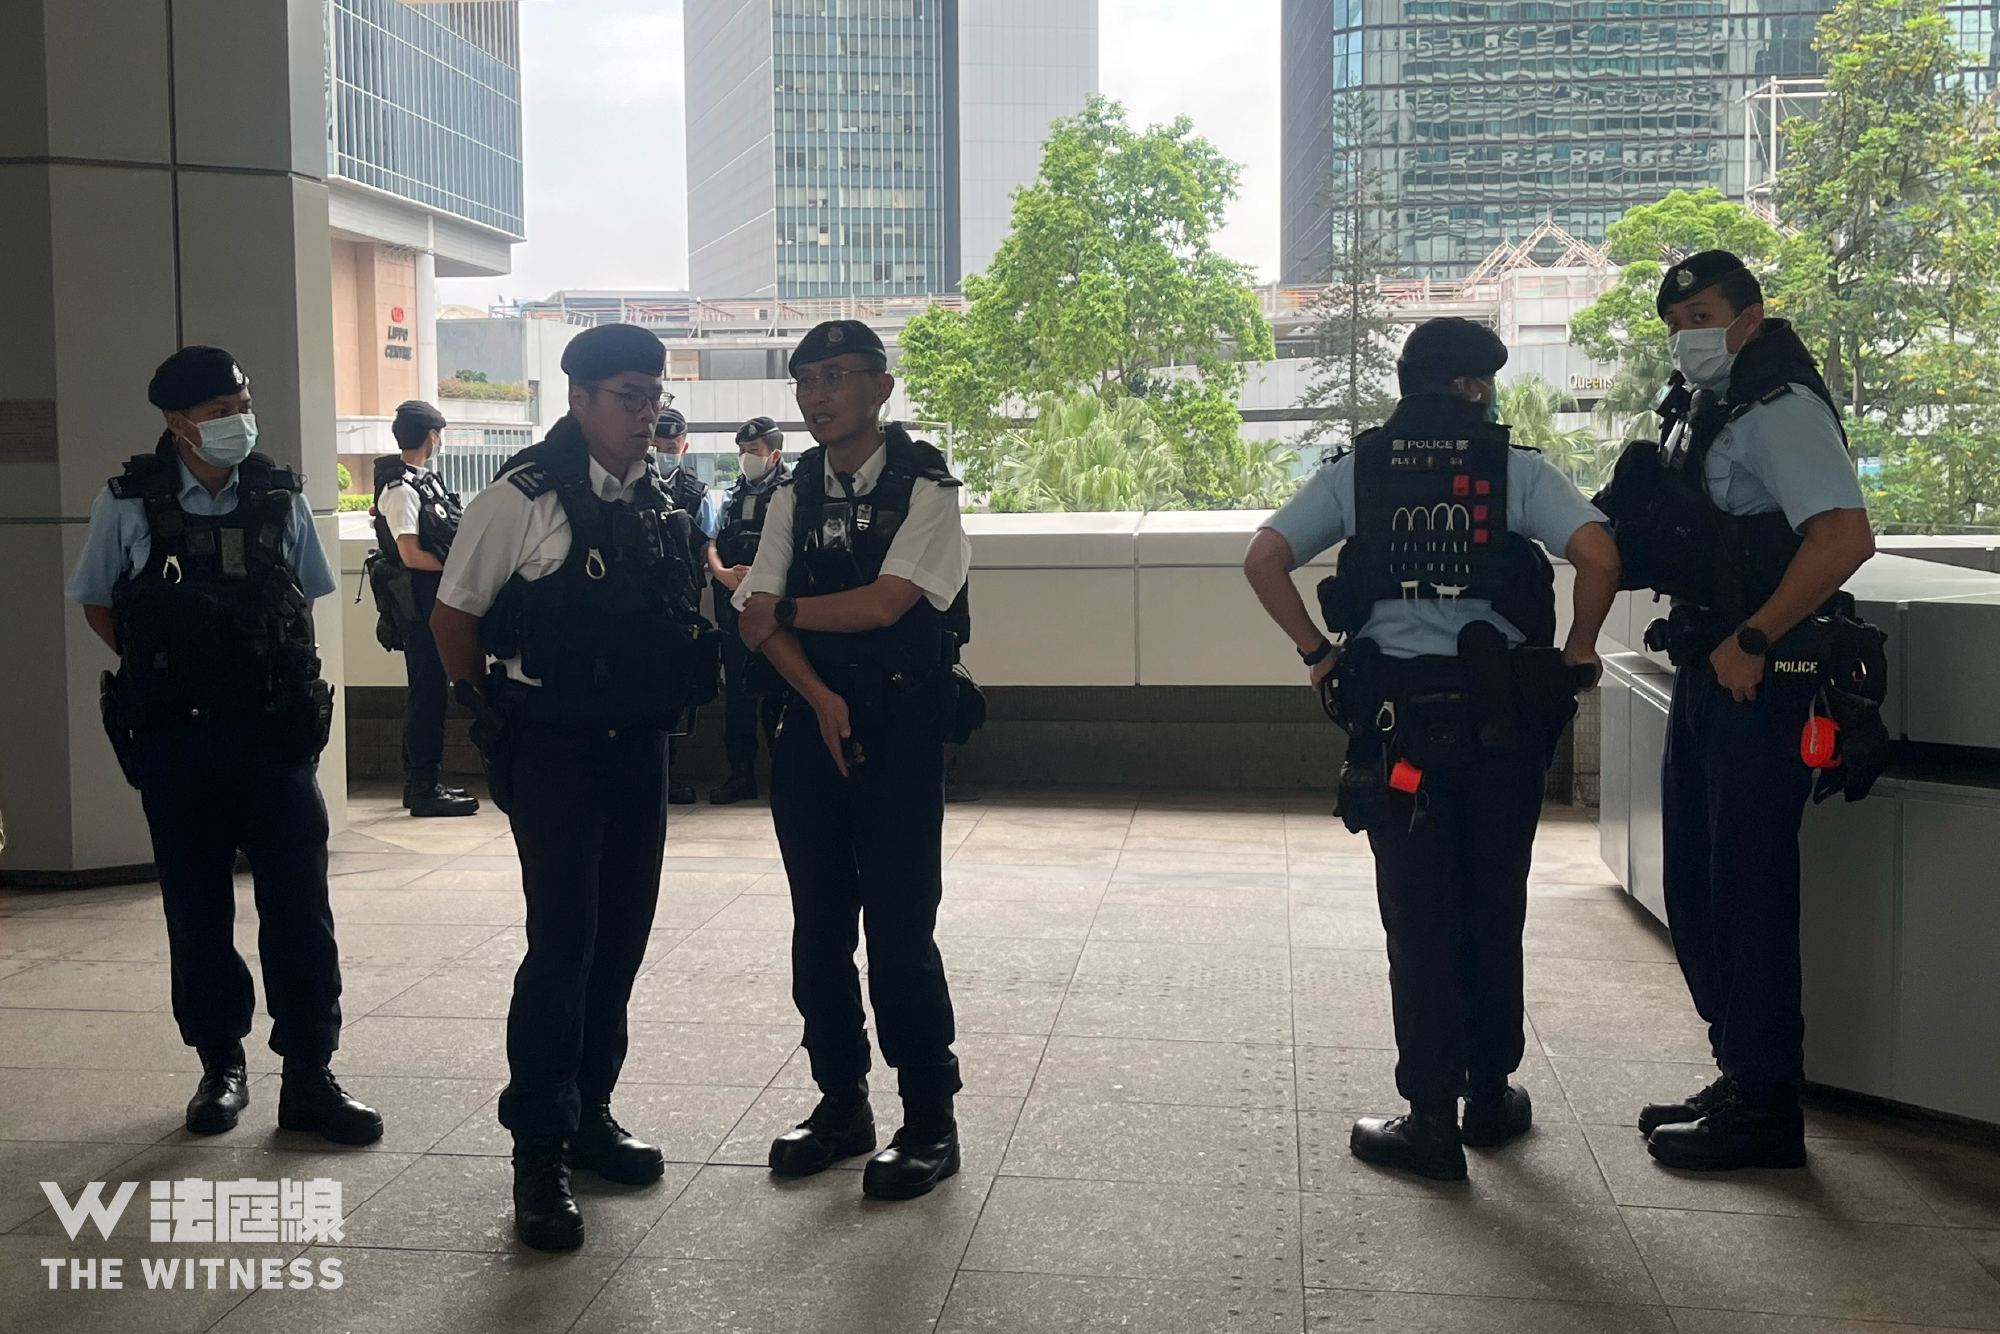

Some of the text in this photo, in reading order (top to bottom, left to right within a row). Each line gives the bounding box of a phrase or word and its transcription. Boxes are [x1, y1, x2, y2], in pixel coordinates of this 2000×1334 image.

[387, 326, 408, 342] LIPPO
[1407, 440, 1454, 450] POLICE
[1774, 660, 1819, 674] POLICE
